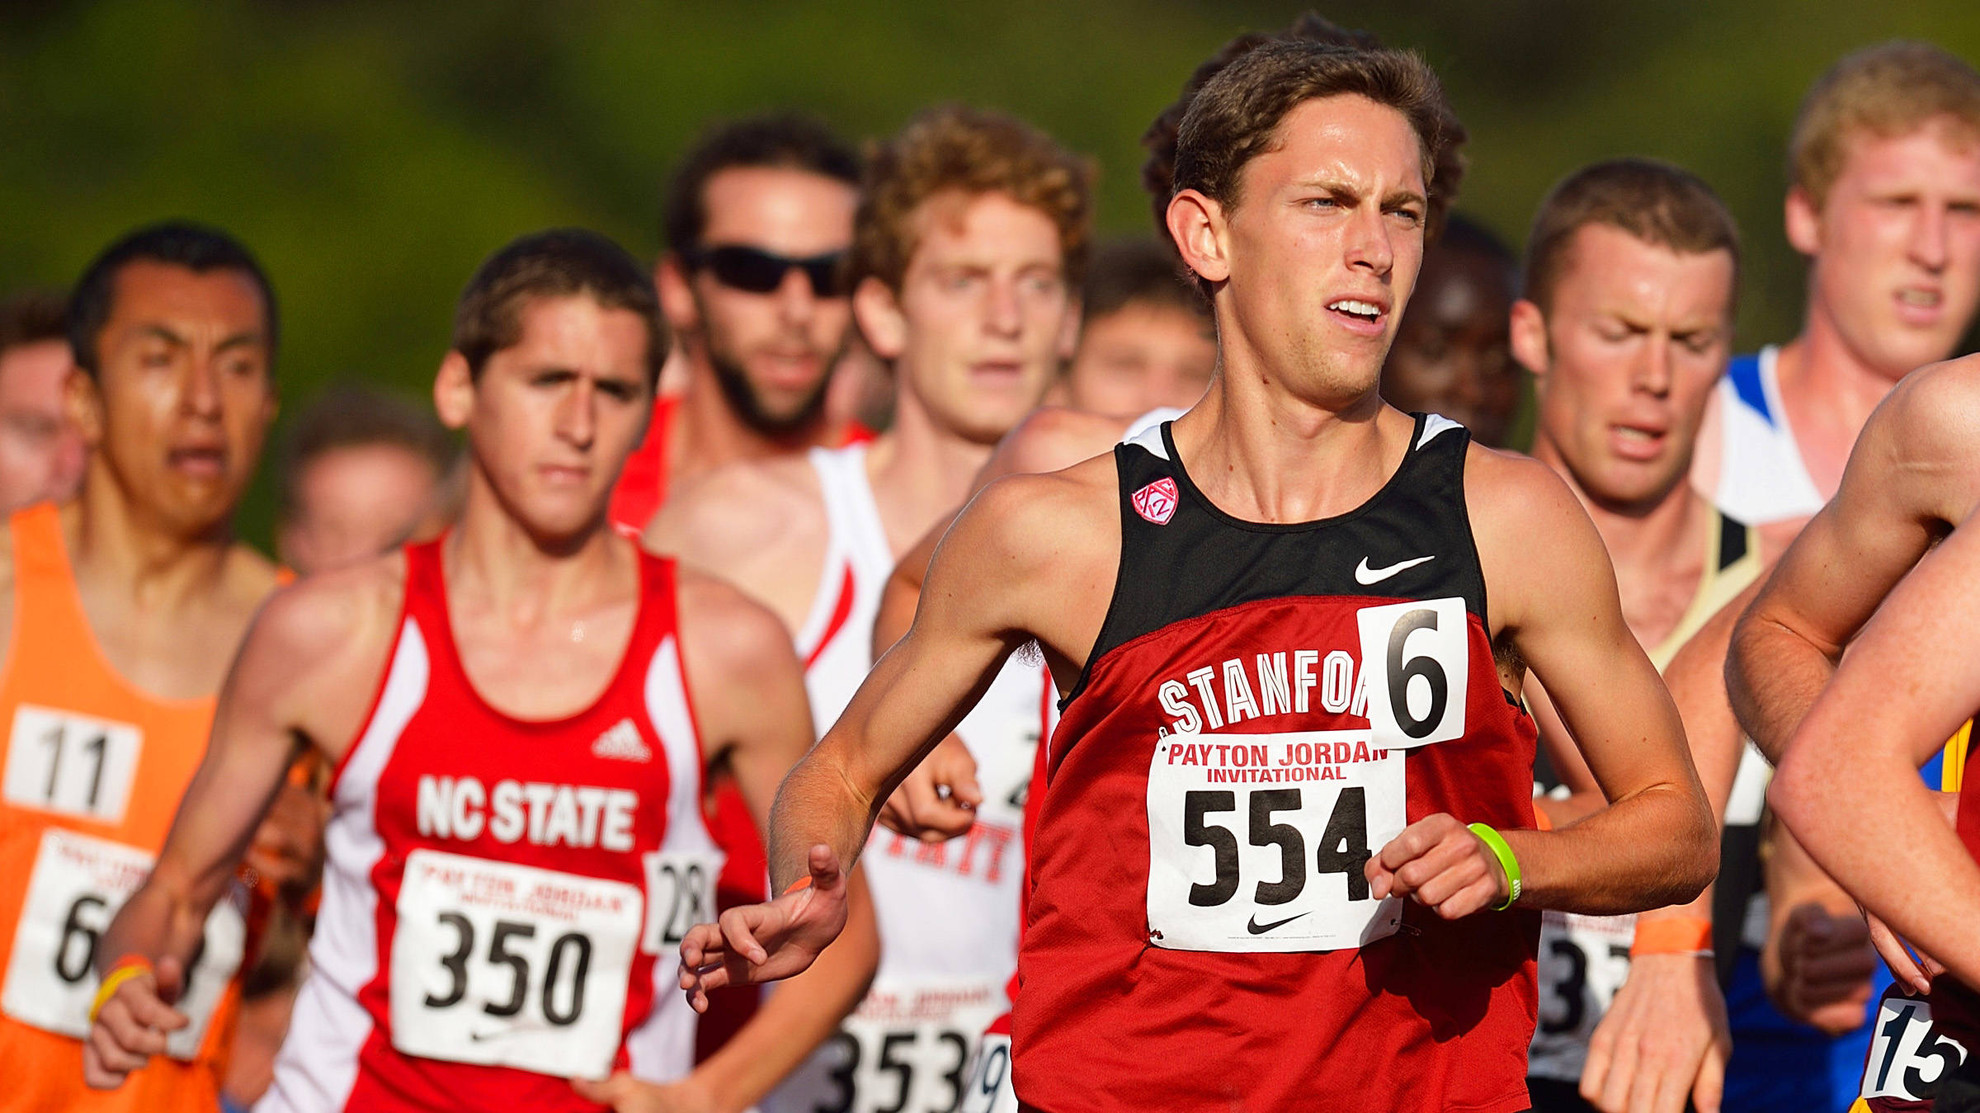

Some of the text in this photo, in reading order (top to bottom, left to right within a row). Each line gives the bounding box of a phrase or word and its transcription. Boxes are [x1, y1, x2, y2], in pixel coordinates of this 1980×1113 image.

[1386, 608, 1449, 739] 6
[40, 723, 108, 809] 11
[1167, 743, 1272, 768] PAYTON
[1206, 766, 1347, 784] INVITATIONAL
[416, 774, 638, 852] NC STATE
[1184, 787, 1373, 908] 554
[424, 911, 593, 1027] 350
[812, 1031, 967, 1113] 353
[1875, 1005, 1962, 1100] 15
